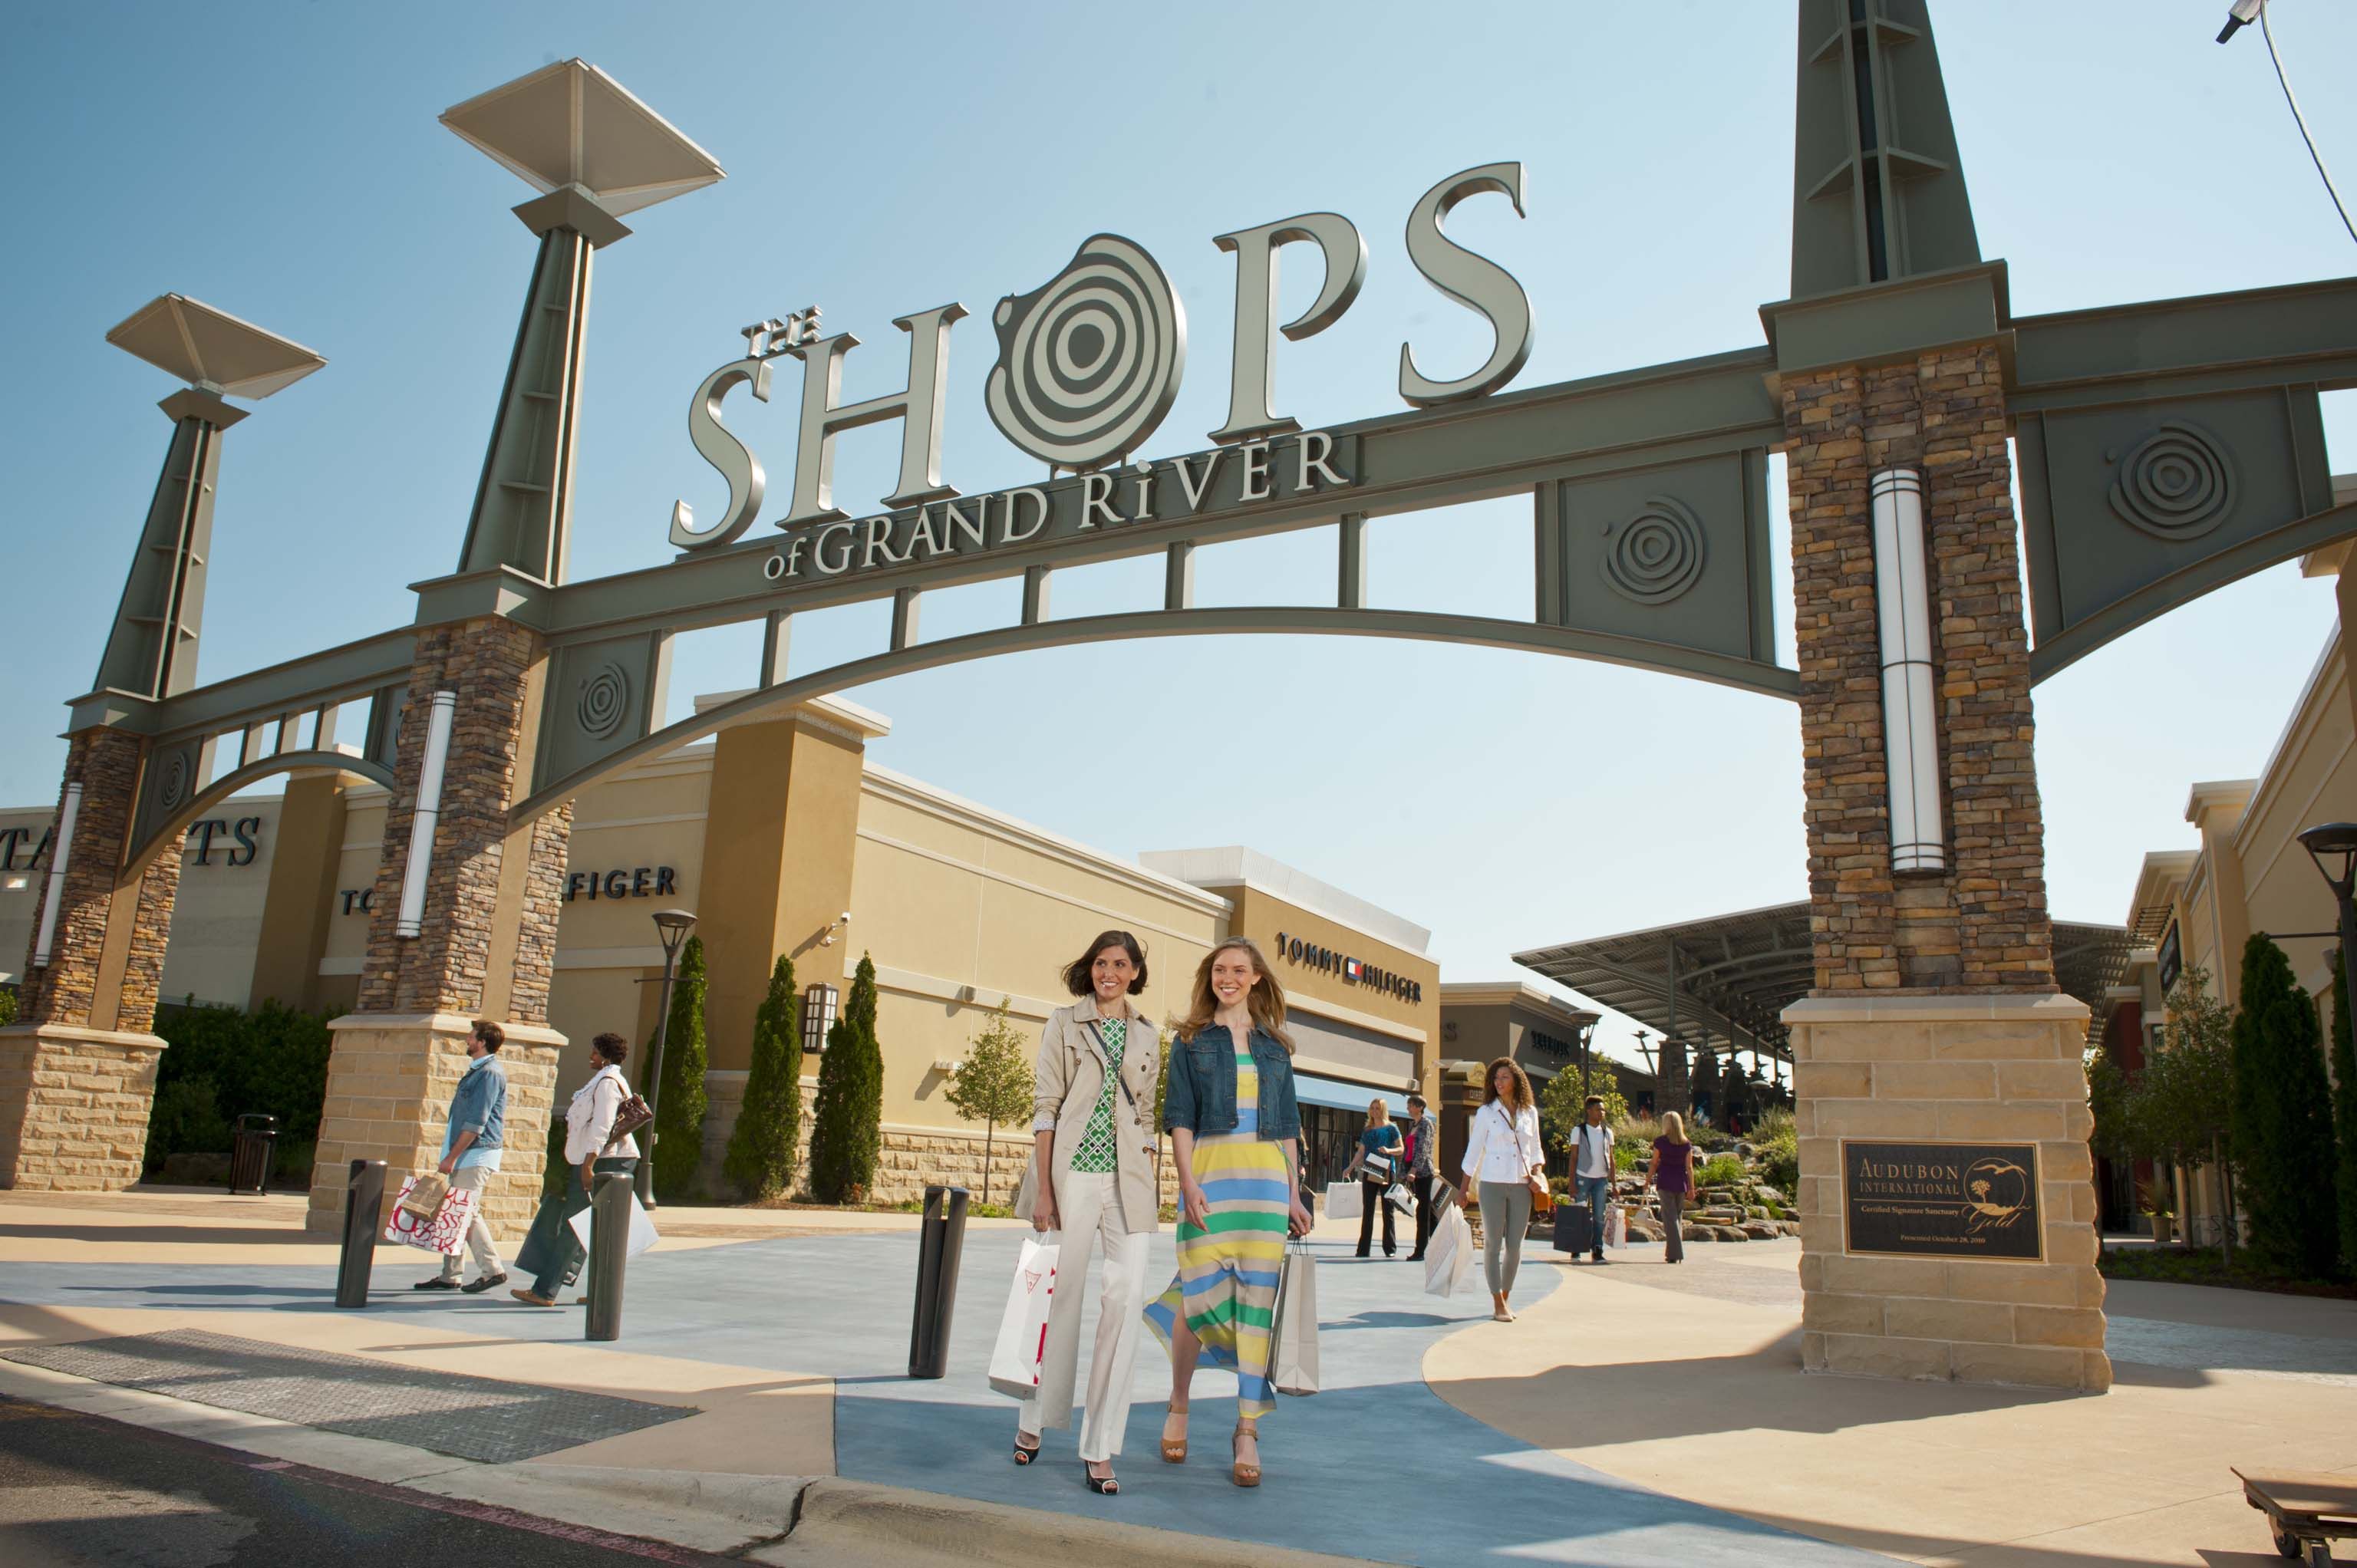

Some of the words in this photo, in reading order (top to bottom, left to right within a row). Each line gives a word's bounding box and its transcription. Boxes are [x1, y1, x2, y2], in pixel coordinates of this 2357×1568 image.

[741, 305, 822, 358] THE
[764, 538, 807, 580] of
[815, 488, 1048, 574] GRAND
[1279, 932, 1343, 974] TOMMY
[1363, 964, 1422, 1003] HILFIGER
[1859, 1158, 1959, 1180] AUDUBON
[1860, 1181, 1960, 1196] INTERNATIONAL
[1861, 1205, 1891, 1214] Certified
[1892, 1207, 1924, 1215] Signature
[1924, 1207, 1959, 1216] Sanctuary
